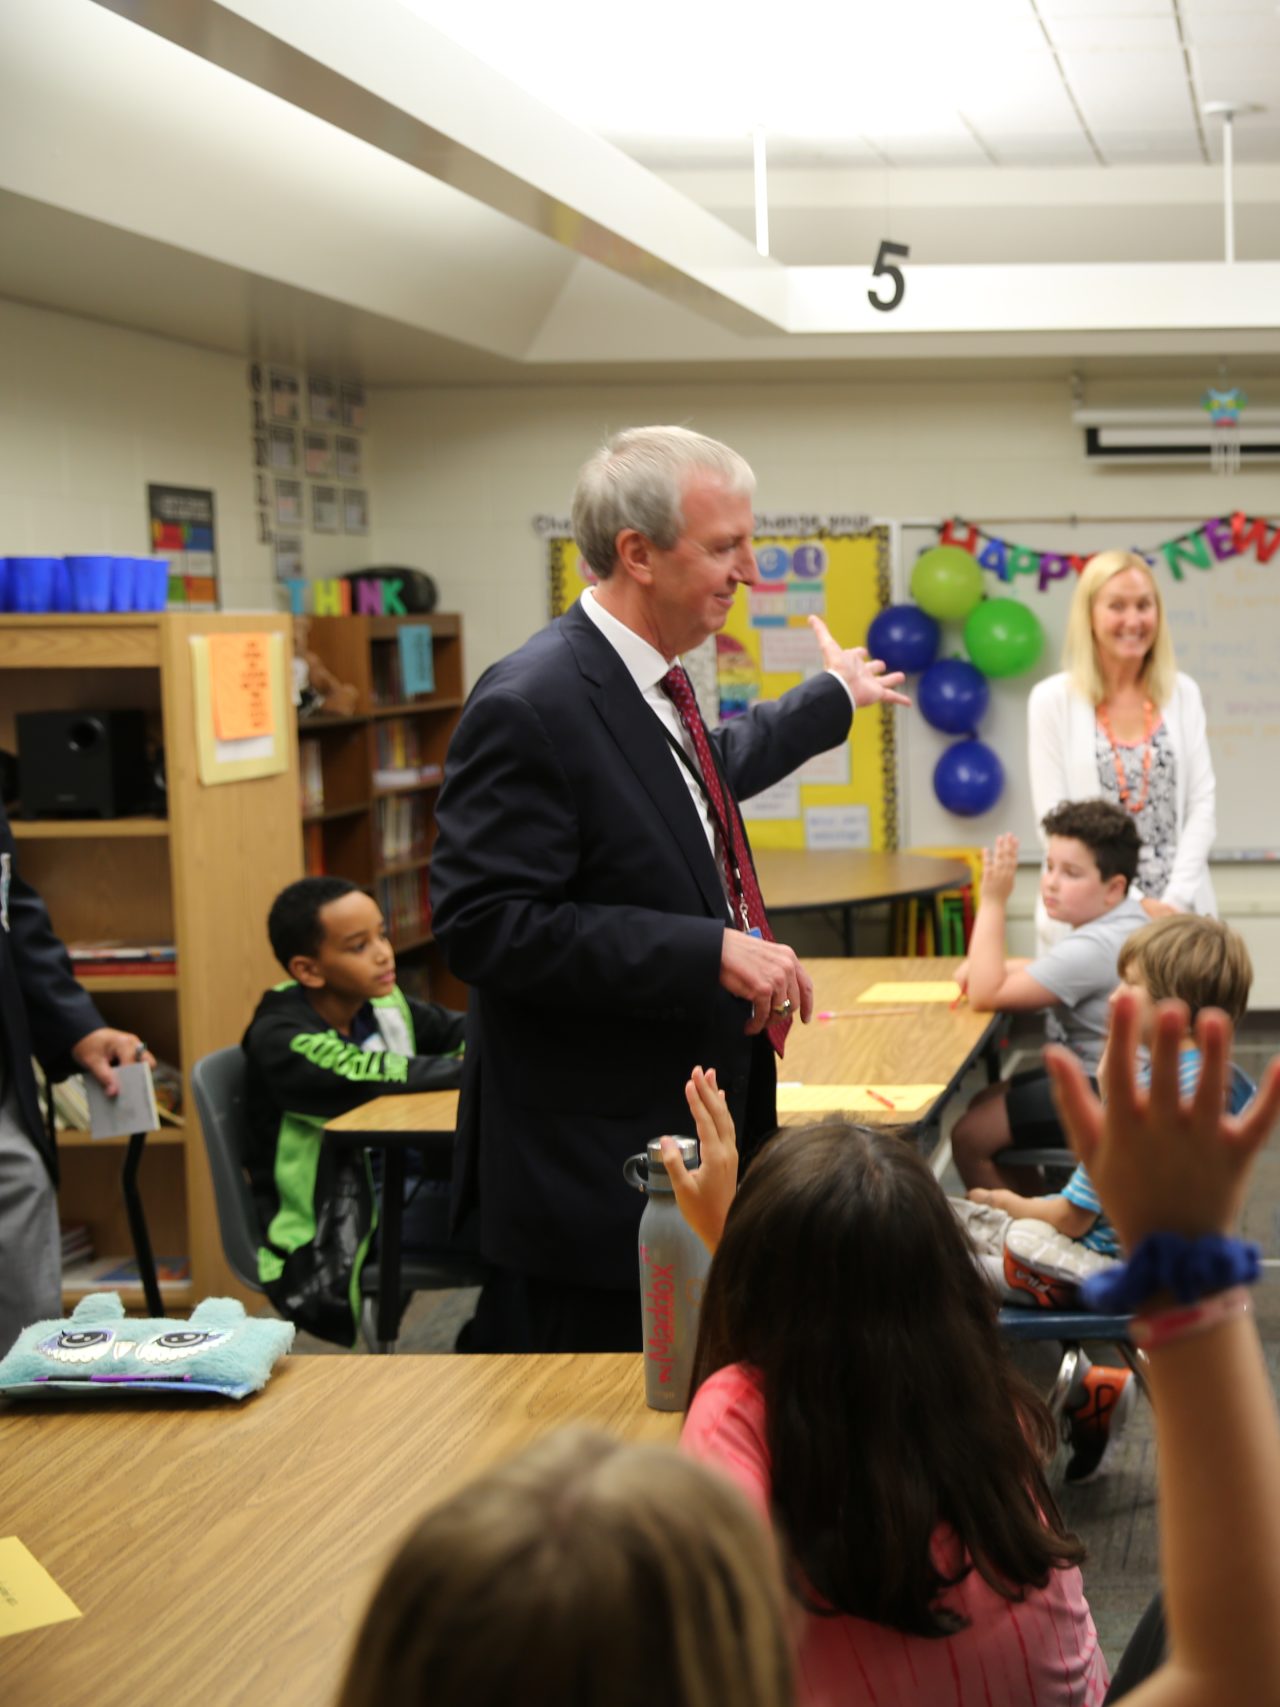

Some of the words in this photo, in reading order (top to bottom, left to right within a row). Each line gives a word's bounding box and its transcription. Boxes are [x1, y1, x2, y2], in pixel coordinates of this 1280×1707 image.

[867, 240, 910, 312] 5
[286, 578, 408, 617] THINK
[646, 1263, 676, 1363] Maddox
